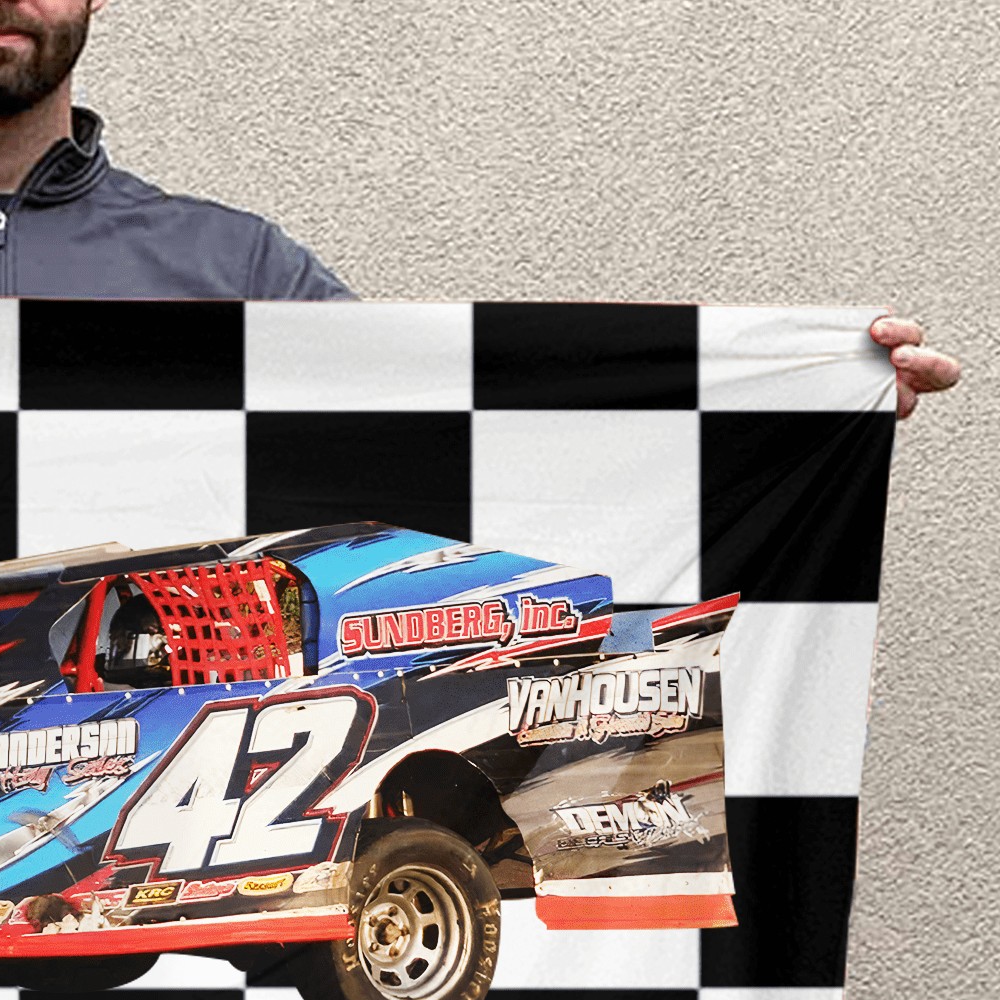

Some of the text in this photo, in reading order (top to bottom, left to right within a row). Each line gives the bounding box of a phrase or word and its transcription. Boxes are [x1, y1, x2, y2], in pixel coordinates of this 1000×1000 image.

[341, 596, 581, 657] SUNDBERG, inc.
[507, 666, 704, 736] VANHOUSEN
[108, 690, 368, 880] 42
